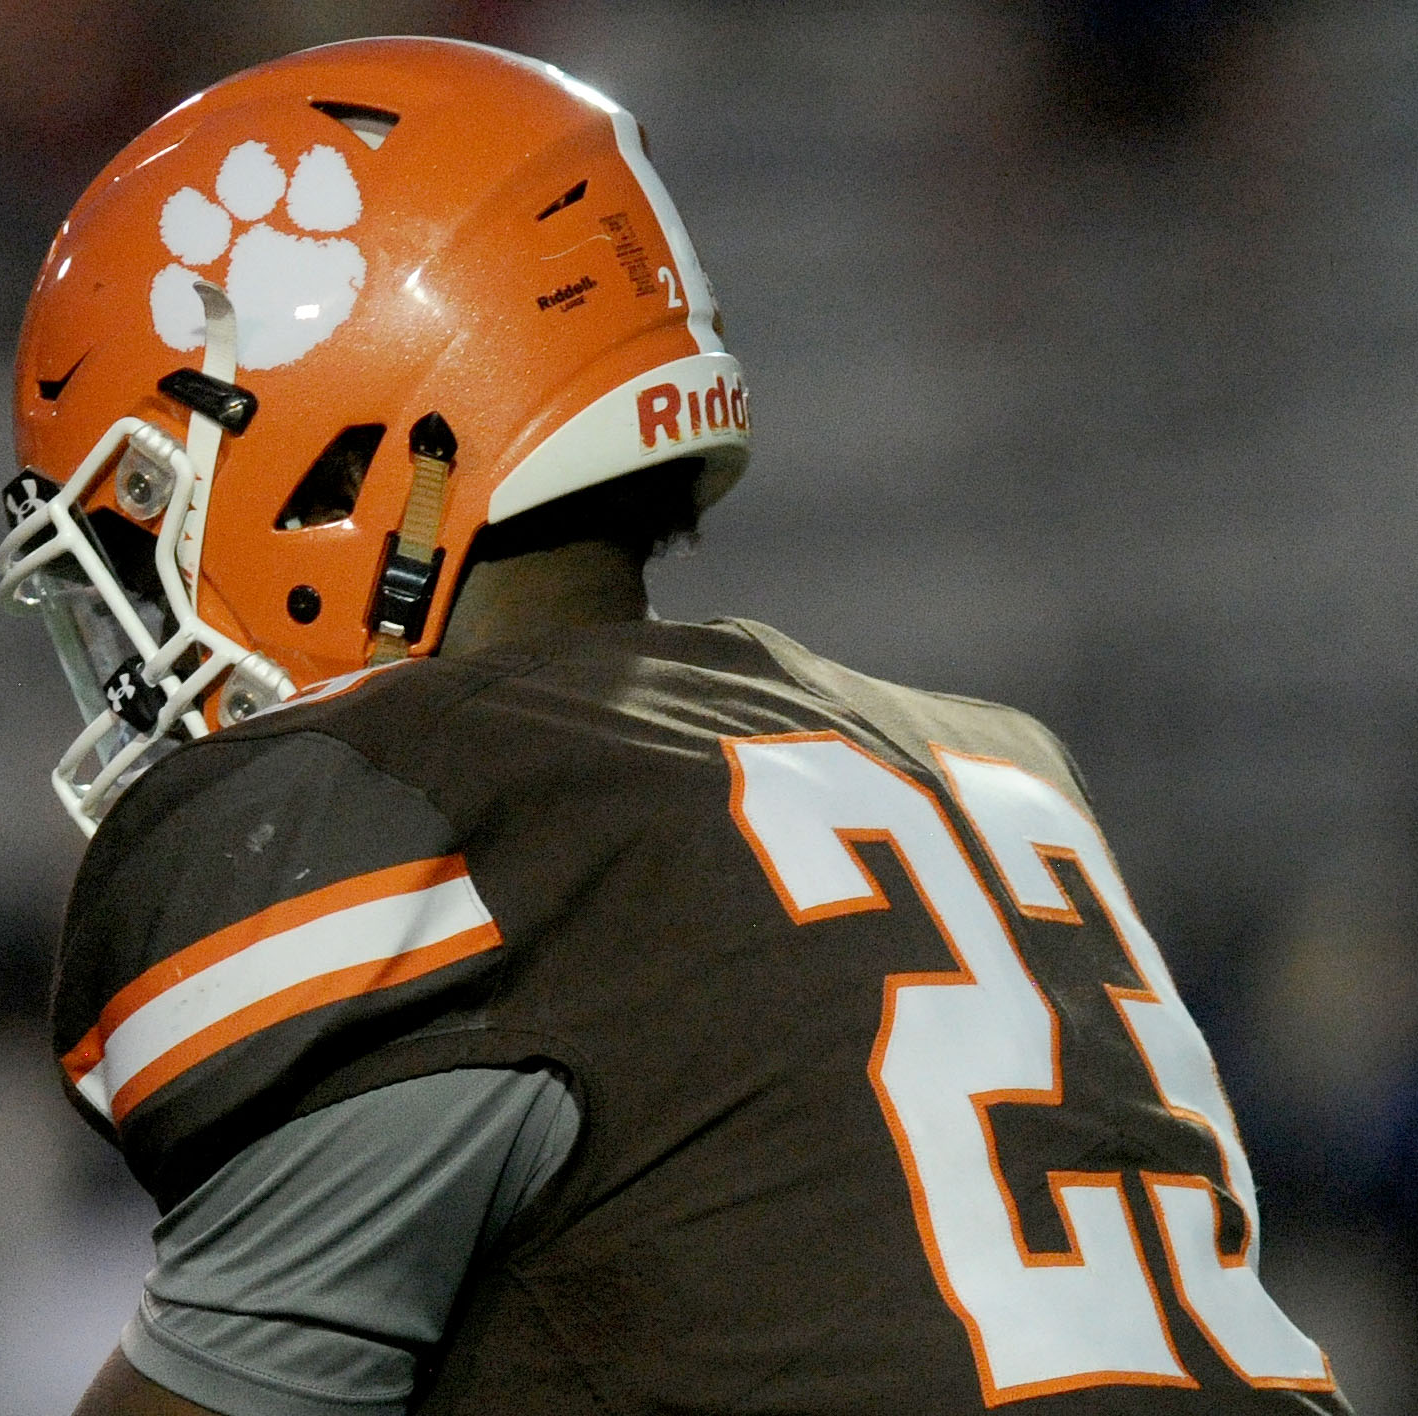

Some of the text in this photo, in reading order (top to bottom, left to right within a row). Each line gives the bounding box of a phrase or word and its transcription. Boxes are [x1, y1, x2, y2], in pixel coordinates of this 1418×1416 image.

[658, 266, 683, 309] 2
[637, 375, 750, 448] Ridd
[720, 730, 1336, 1408] 23
